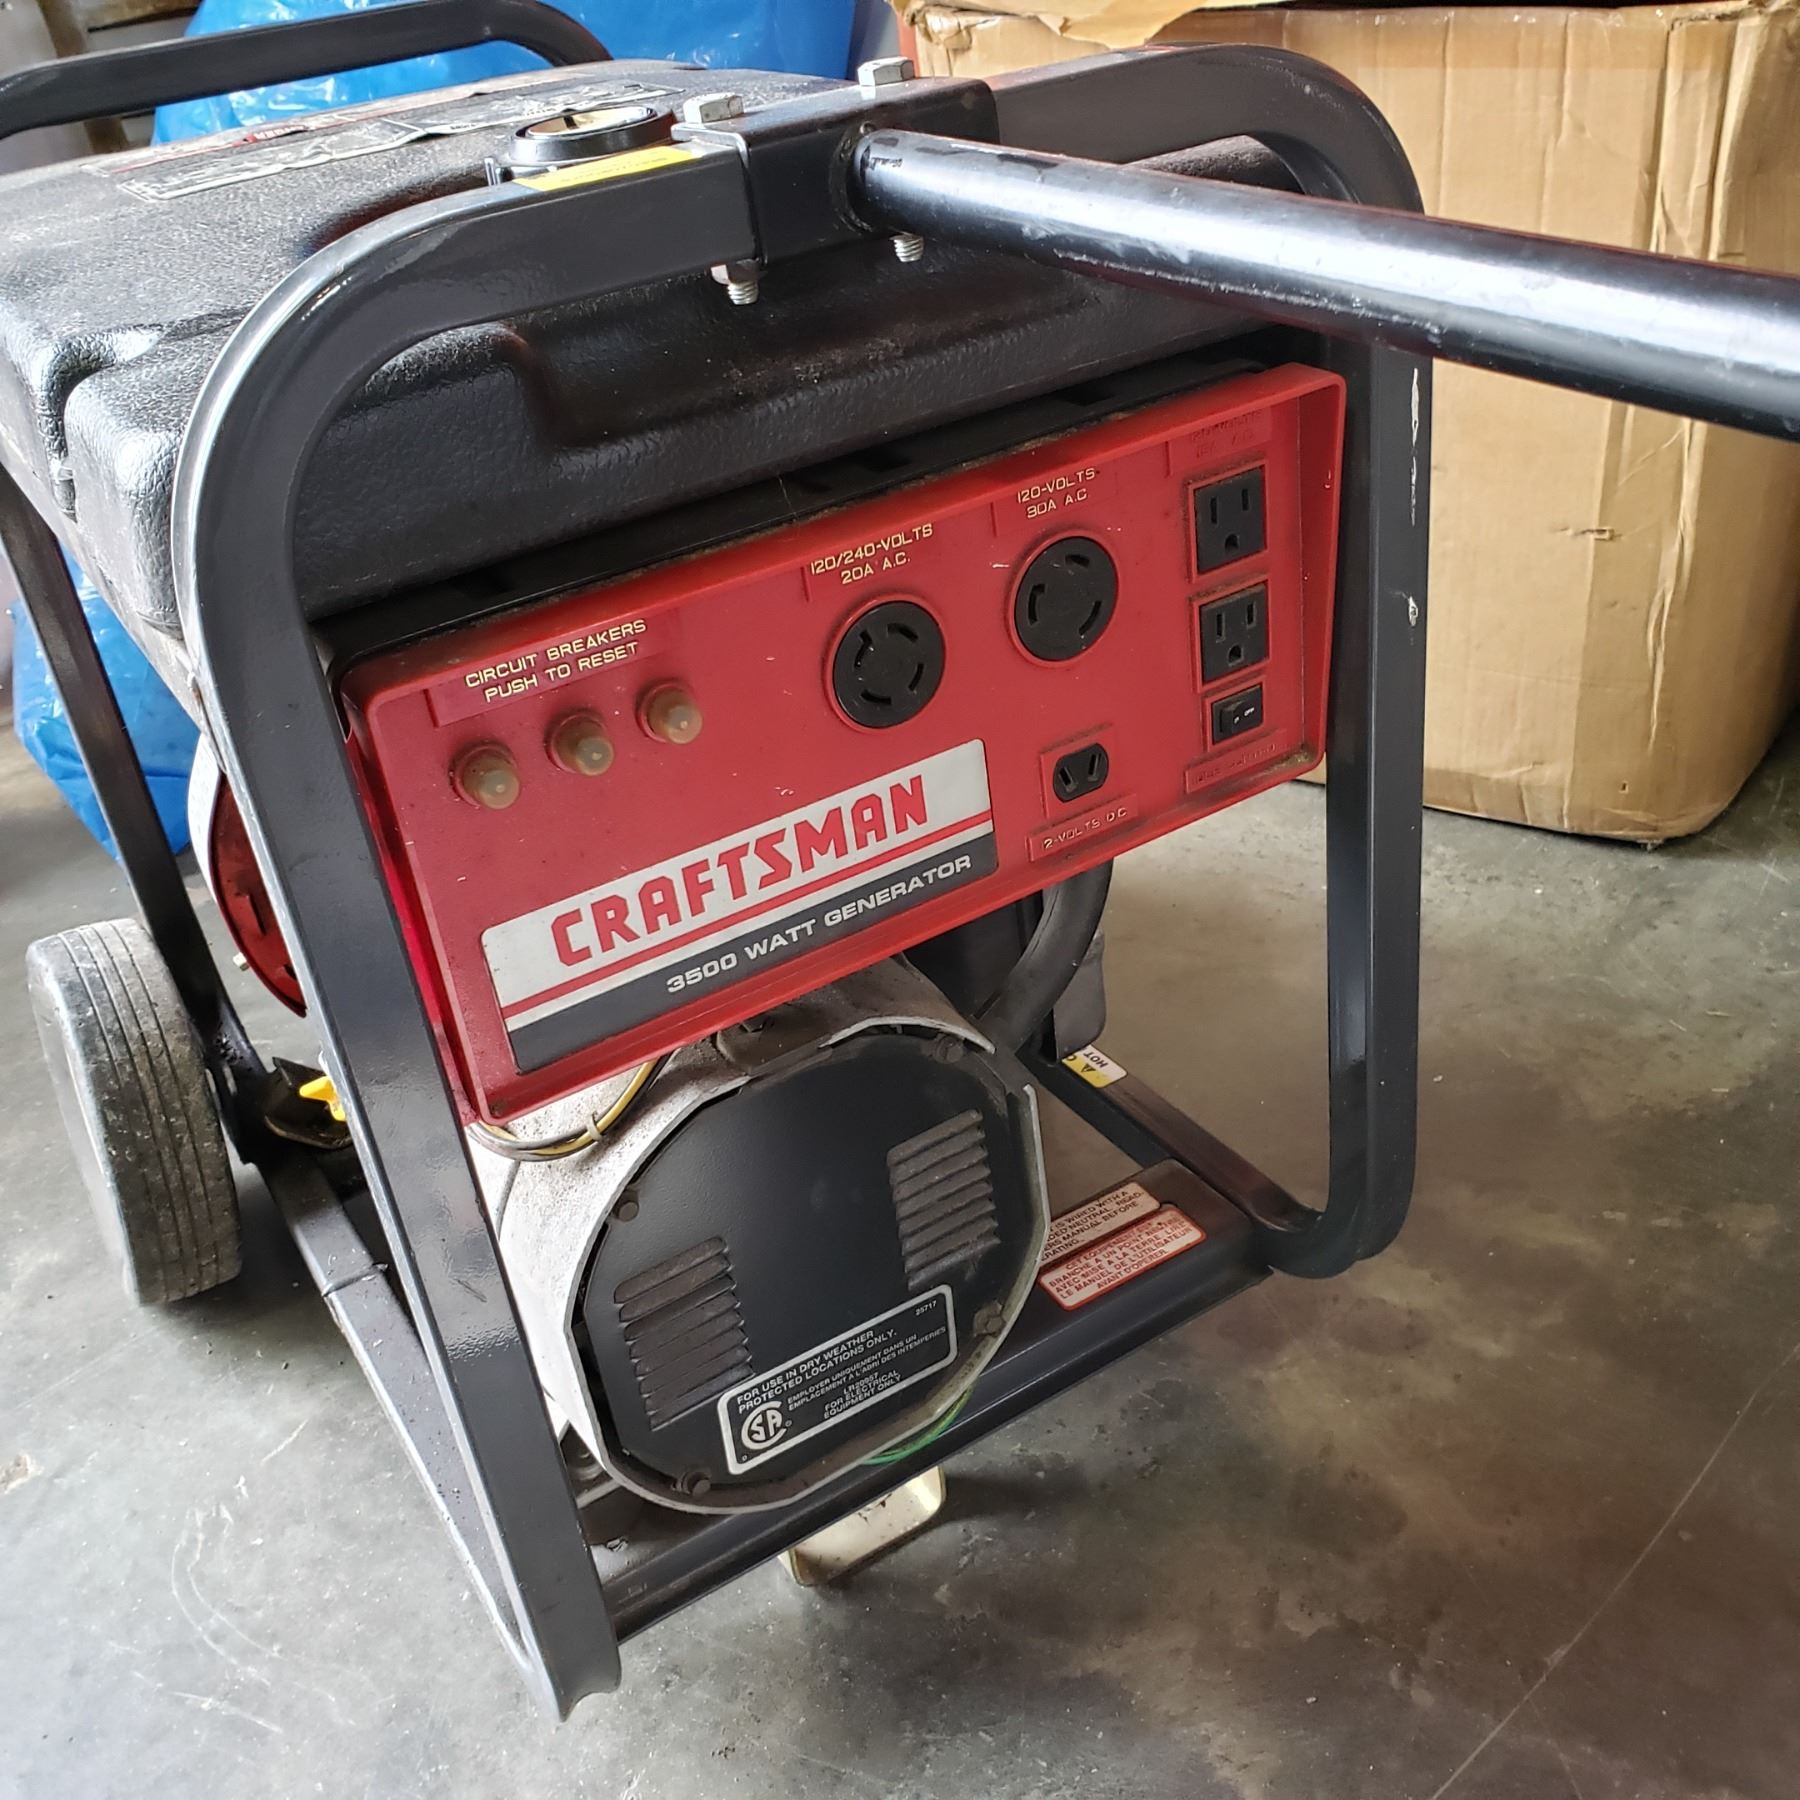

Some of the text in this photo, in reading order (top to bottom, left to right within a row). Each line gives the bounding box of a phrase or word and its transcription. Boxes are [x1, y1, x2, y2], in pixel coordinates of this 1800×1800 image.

[1017, 467, 1095, 503] 120-VOLTS
[810, 523, 933, 575] 120/240-VOLTS
[841, 564, 874, 585] 20A
[465, 619, 647, 688] CIRCUIT BREAKERS
[484, 642, 639, 703] PUSH TO RESET
[551, 774, 928, 967] CRAFTSMAN
[667, 854, 972, 993] 3500 WATT GENERATOR
[1083, 1051, 1109, 1068] HOT
[1062, 1220, 1102, 1241] MANUAL
[1102, 1201, 1138, 1221] BEFORE
[1065, 1206, 1096, 1223] WIRED
[1056, 1277, 1080, 1294] AVEC
[1116, 1251, 1129, 1261] LA
[1060, 1288, 1074, 1299] LE
[1074, 1269, 1113, 1292] MANUEL
[1114, 1260, 1128, 1271] DE
[1097, 1271, 1124, 1289] AVANT
[737, 1330, 874, 1405] FOR USE IN DRY WEATHER
[738, 1329, 897, 1414] PROTECTED LOCATIONS ONLY.
[787, 1334, 917, 1404] EMPLOYER UNIQUEMENT DANS UN
[788, 1377, 847, 1411] EMPLACEMENT
[881, 1353, 897, 1364] DES
[897, 1326, 946, 1356] INTEMPERIES
[825, 1369, 900, 1411] FOR ELECTRICAL
[823, 1374, 901, 1419] EQUIPMENT ONLY
